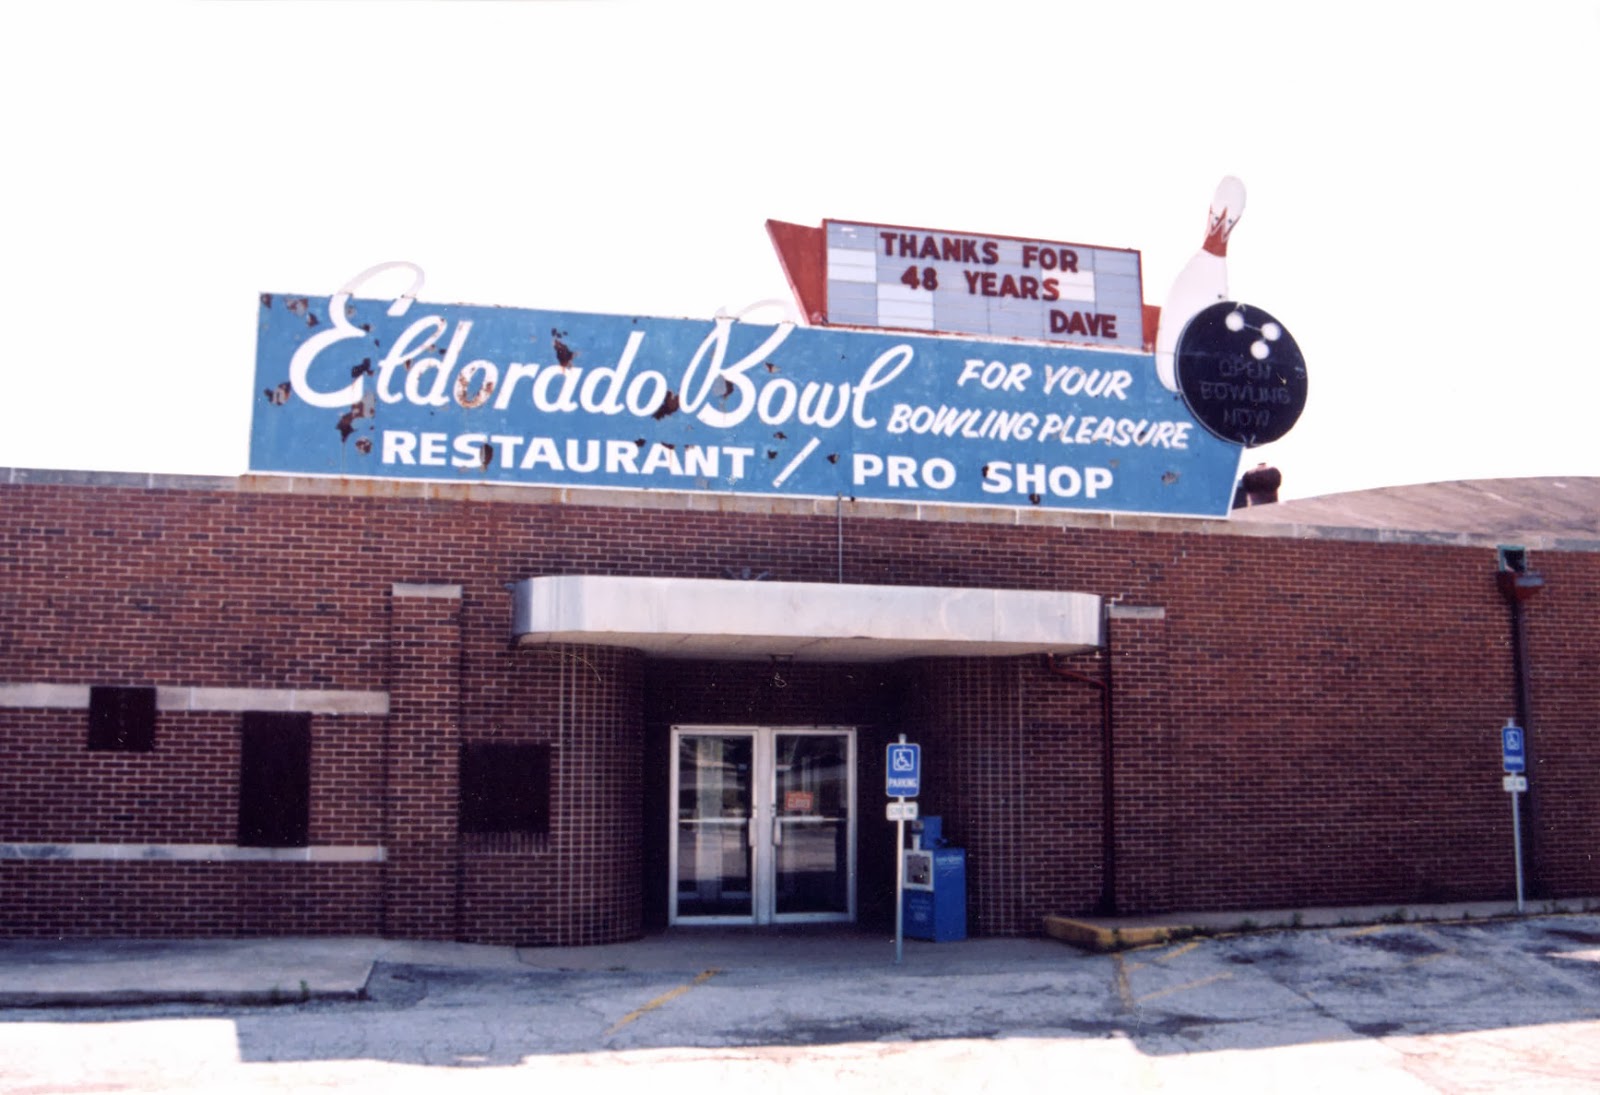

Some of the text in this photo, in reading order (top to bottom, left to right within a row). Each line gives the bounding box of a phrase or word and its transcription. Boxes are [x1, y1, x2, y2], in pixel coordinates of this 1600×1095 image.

[880, 232, 1079, 273] THANKS FOR
[901, 265, 1060, 301] 48 YEARS
[1050, 310, 1118, 339] DAVE
[289, 261, 914, 429] Eldorado Bowl
[957, 360, 1133, 401] FOR YOUR
[1219, 359, 1271, 379] OPEN
[1201, 382, 1290, 404] BOWLING
[887, 404, 1193, 449] BOWLING PLEASURE
[1223, 409, 1270, 426] NOW
[383, 430, 754, 478] RESTAURANT
[852, 454, 956, 489] PRO
[982, 461, 1114, 499] SHOP
